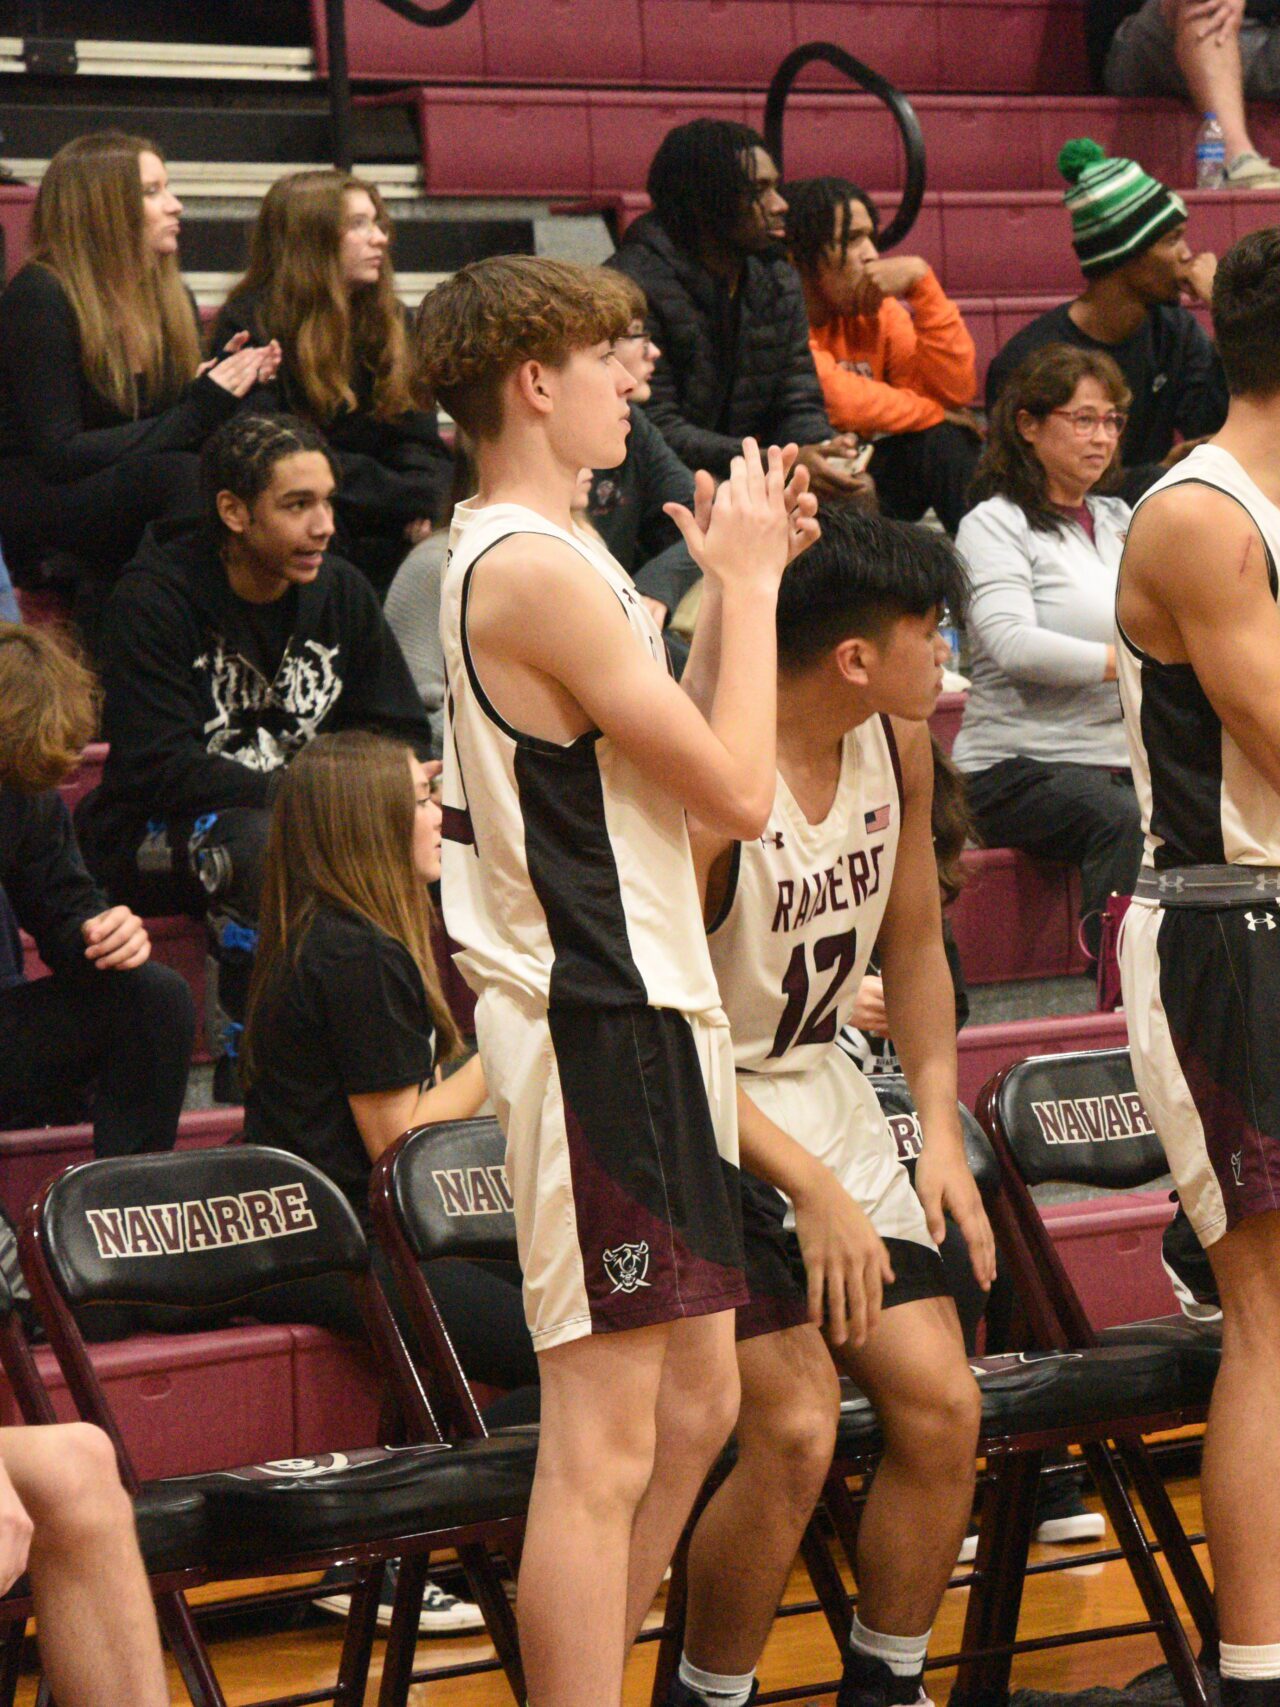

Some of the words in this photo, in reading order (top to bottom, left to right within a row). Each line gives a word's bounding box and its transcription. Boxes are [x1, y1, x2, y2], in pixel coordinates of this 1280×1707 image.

[766, 927, 857, 1059] 12
[1031, 1091, 1156, 1145] NAVAR
[85, 1183, 317, 1258] NAVARRE
